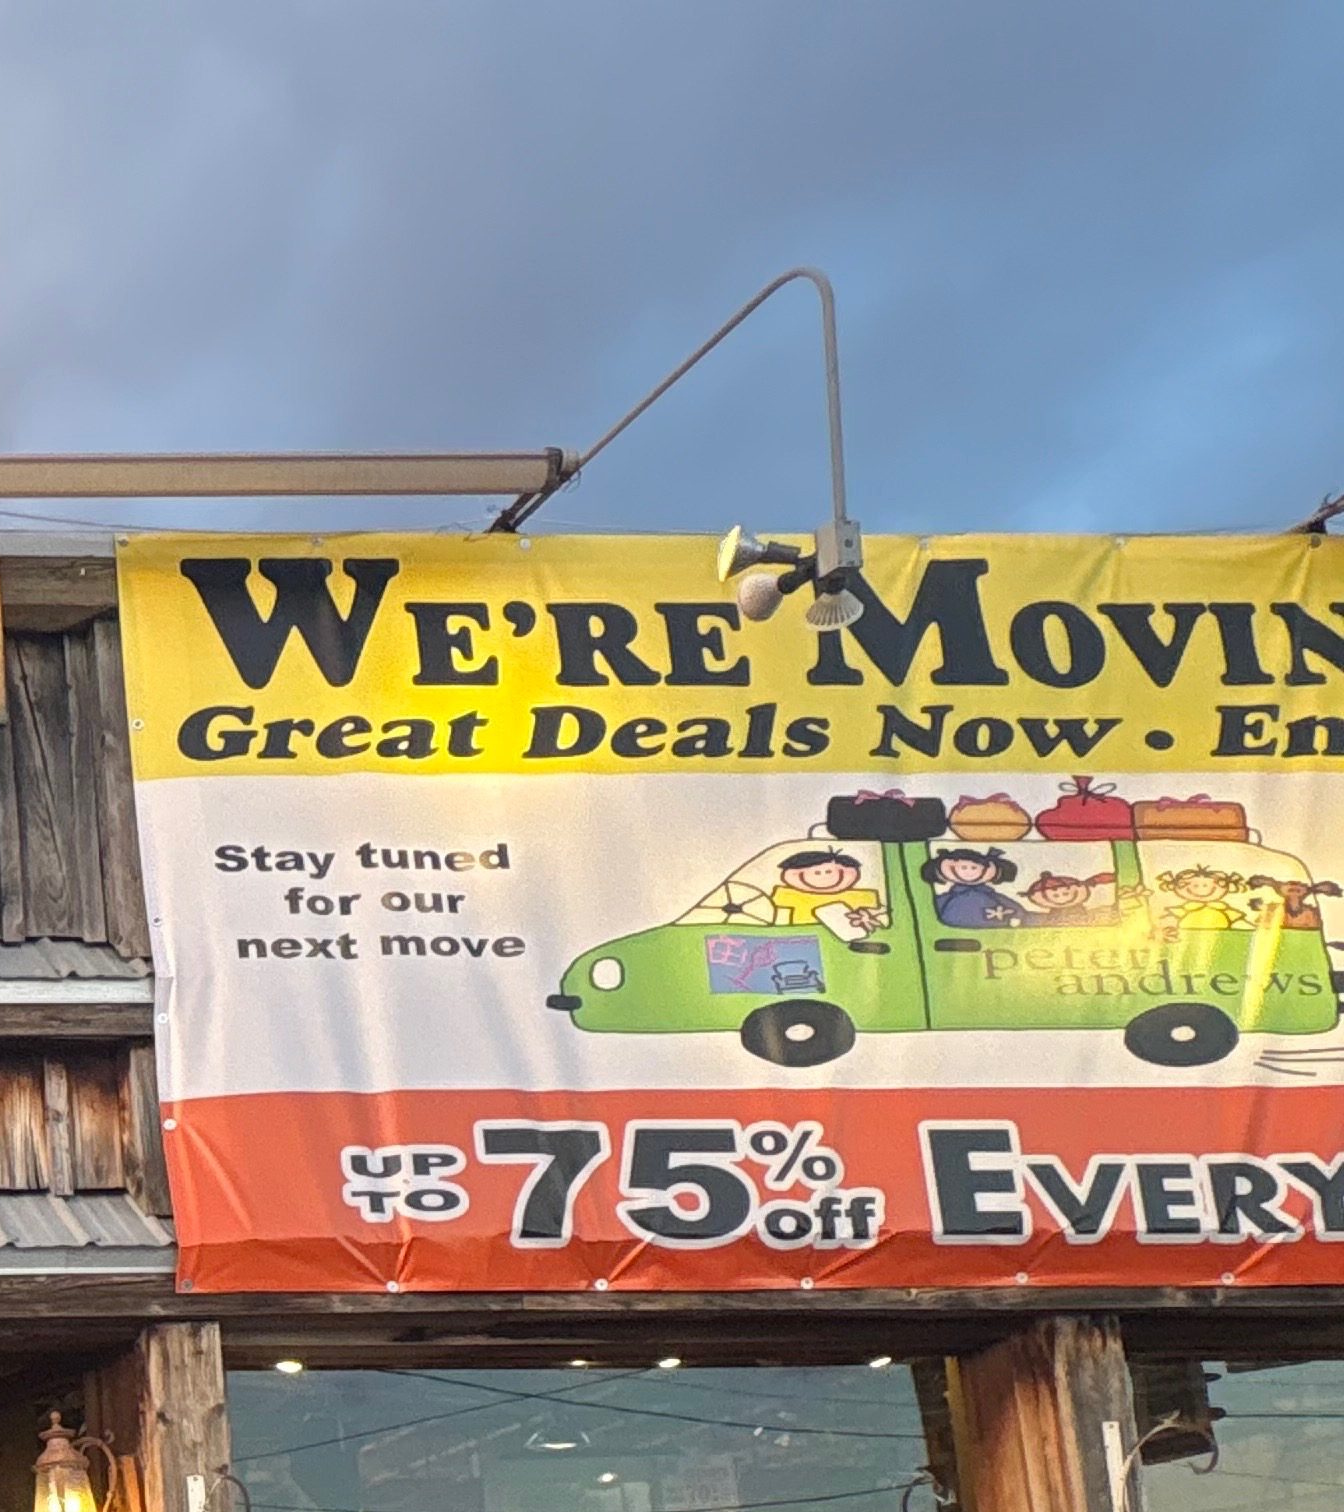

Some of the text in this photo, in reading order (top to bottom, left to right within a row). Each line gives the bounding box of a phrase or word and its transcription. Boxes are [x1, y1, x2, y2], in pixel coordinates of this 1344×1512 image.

[177, 706, 488, 761] Great
[522, 703, 830, 760] Deals
[870, 705, 1124, 759] Now
[215, 842, 511, 881] Stay tuned
[284, 887, 465, 917] for our
[236, 932, 526, 961] next move
[982, 945, 1151, 980] peter
[348, 1151, 458, 1179] UP
[350, 1188, 462, 1215] TO
[765, 1197, 875, 1242] off
